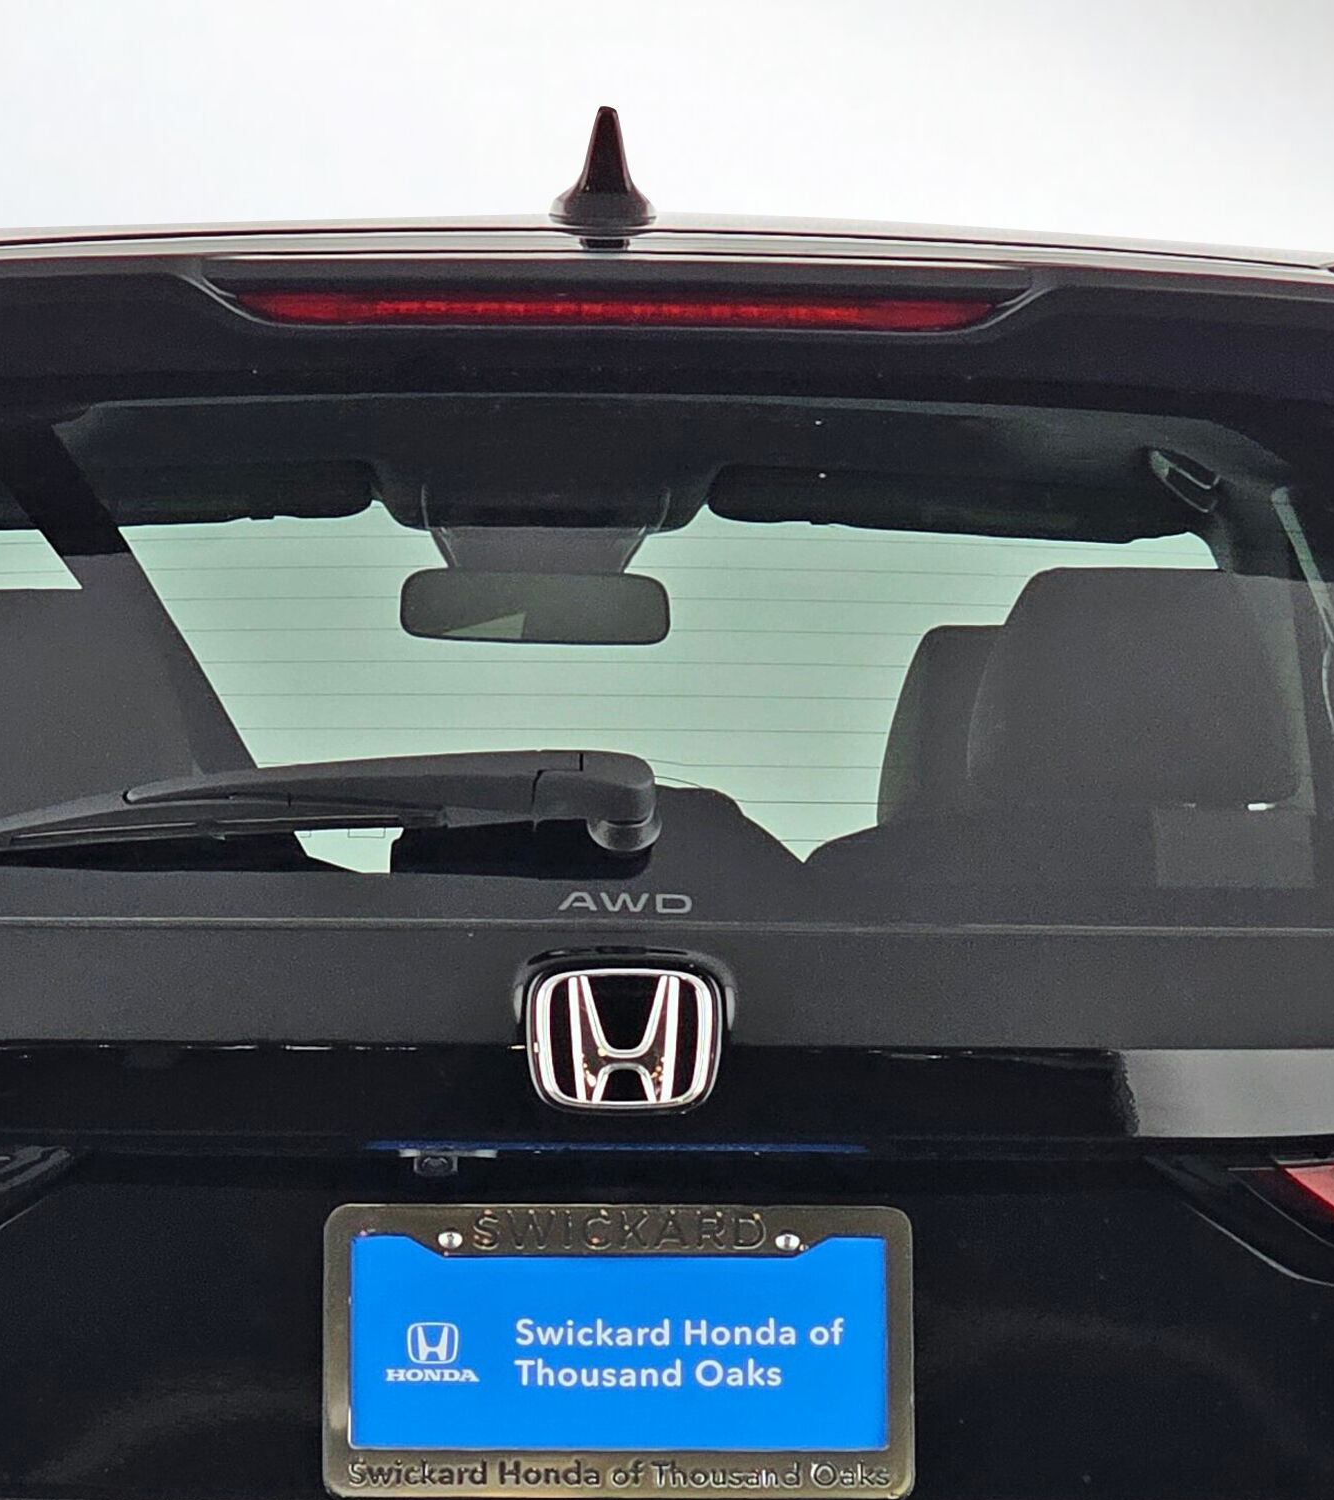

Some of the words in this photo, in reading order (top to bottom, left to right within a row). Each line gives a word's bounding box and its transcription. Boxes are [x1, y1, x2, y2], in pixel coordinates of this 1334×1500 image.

[558, 891, 693, 914] AWD
[471, 1208, 767, 1250] SWICKARD
[514, 1317, 670, 1347] Swickard
[683, 1316, 797, 1347] Honda
[808, 1316, 845, 1347] of
[385, 1368, 481, 1383] HONDA
[513, 1357, 683, 1388] Thousand
[694, 1357, 783, 1388] Oaks
[348, 1458, 489, 1488] Swickard
[497, 1458, 602, 1488] Honda
[610, 1458, 646, 1489] of
[650, 1459, 804, 1489] Thousand
[809, 1459, 892, 1489] Oaks
